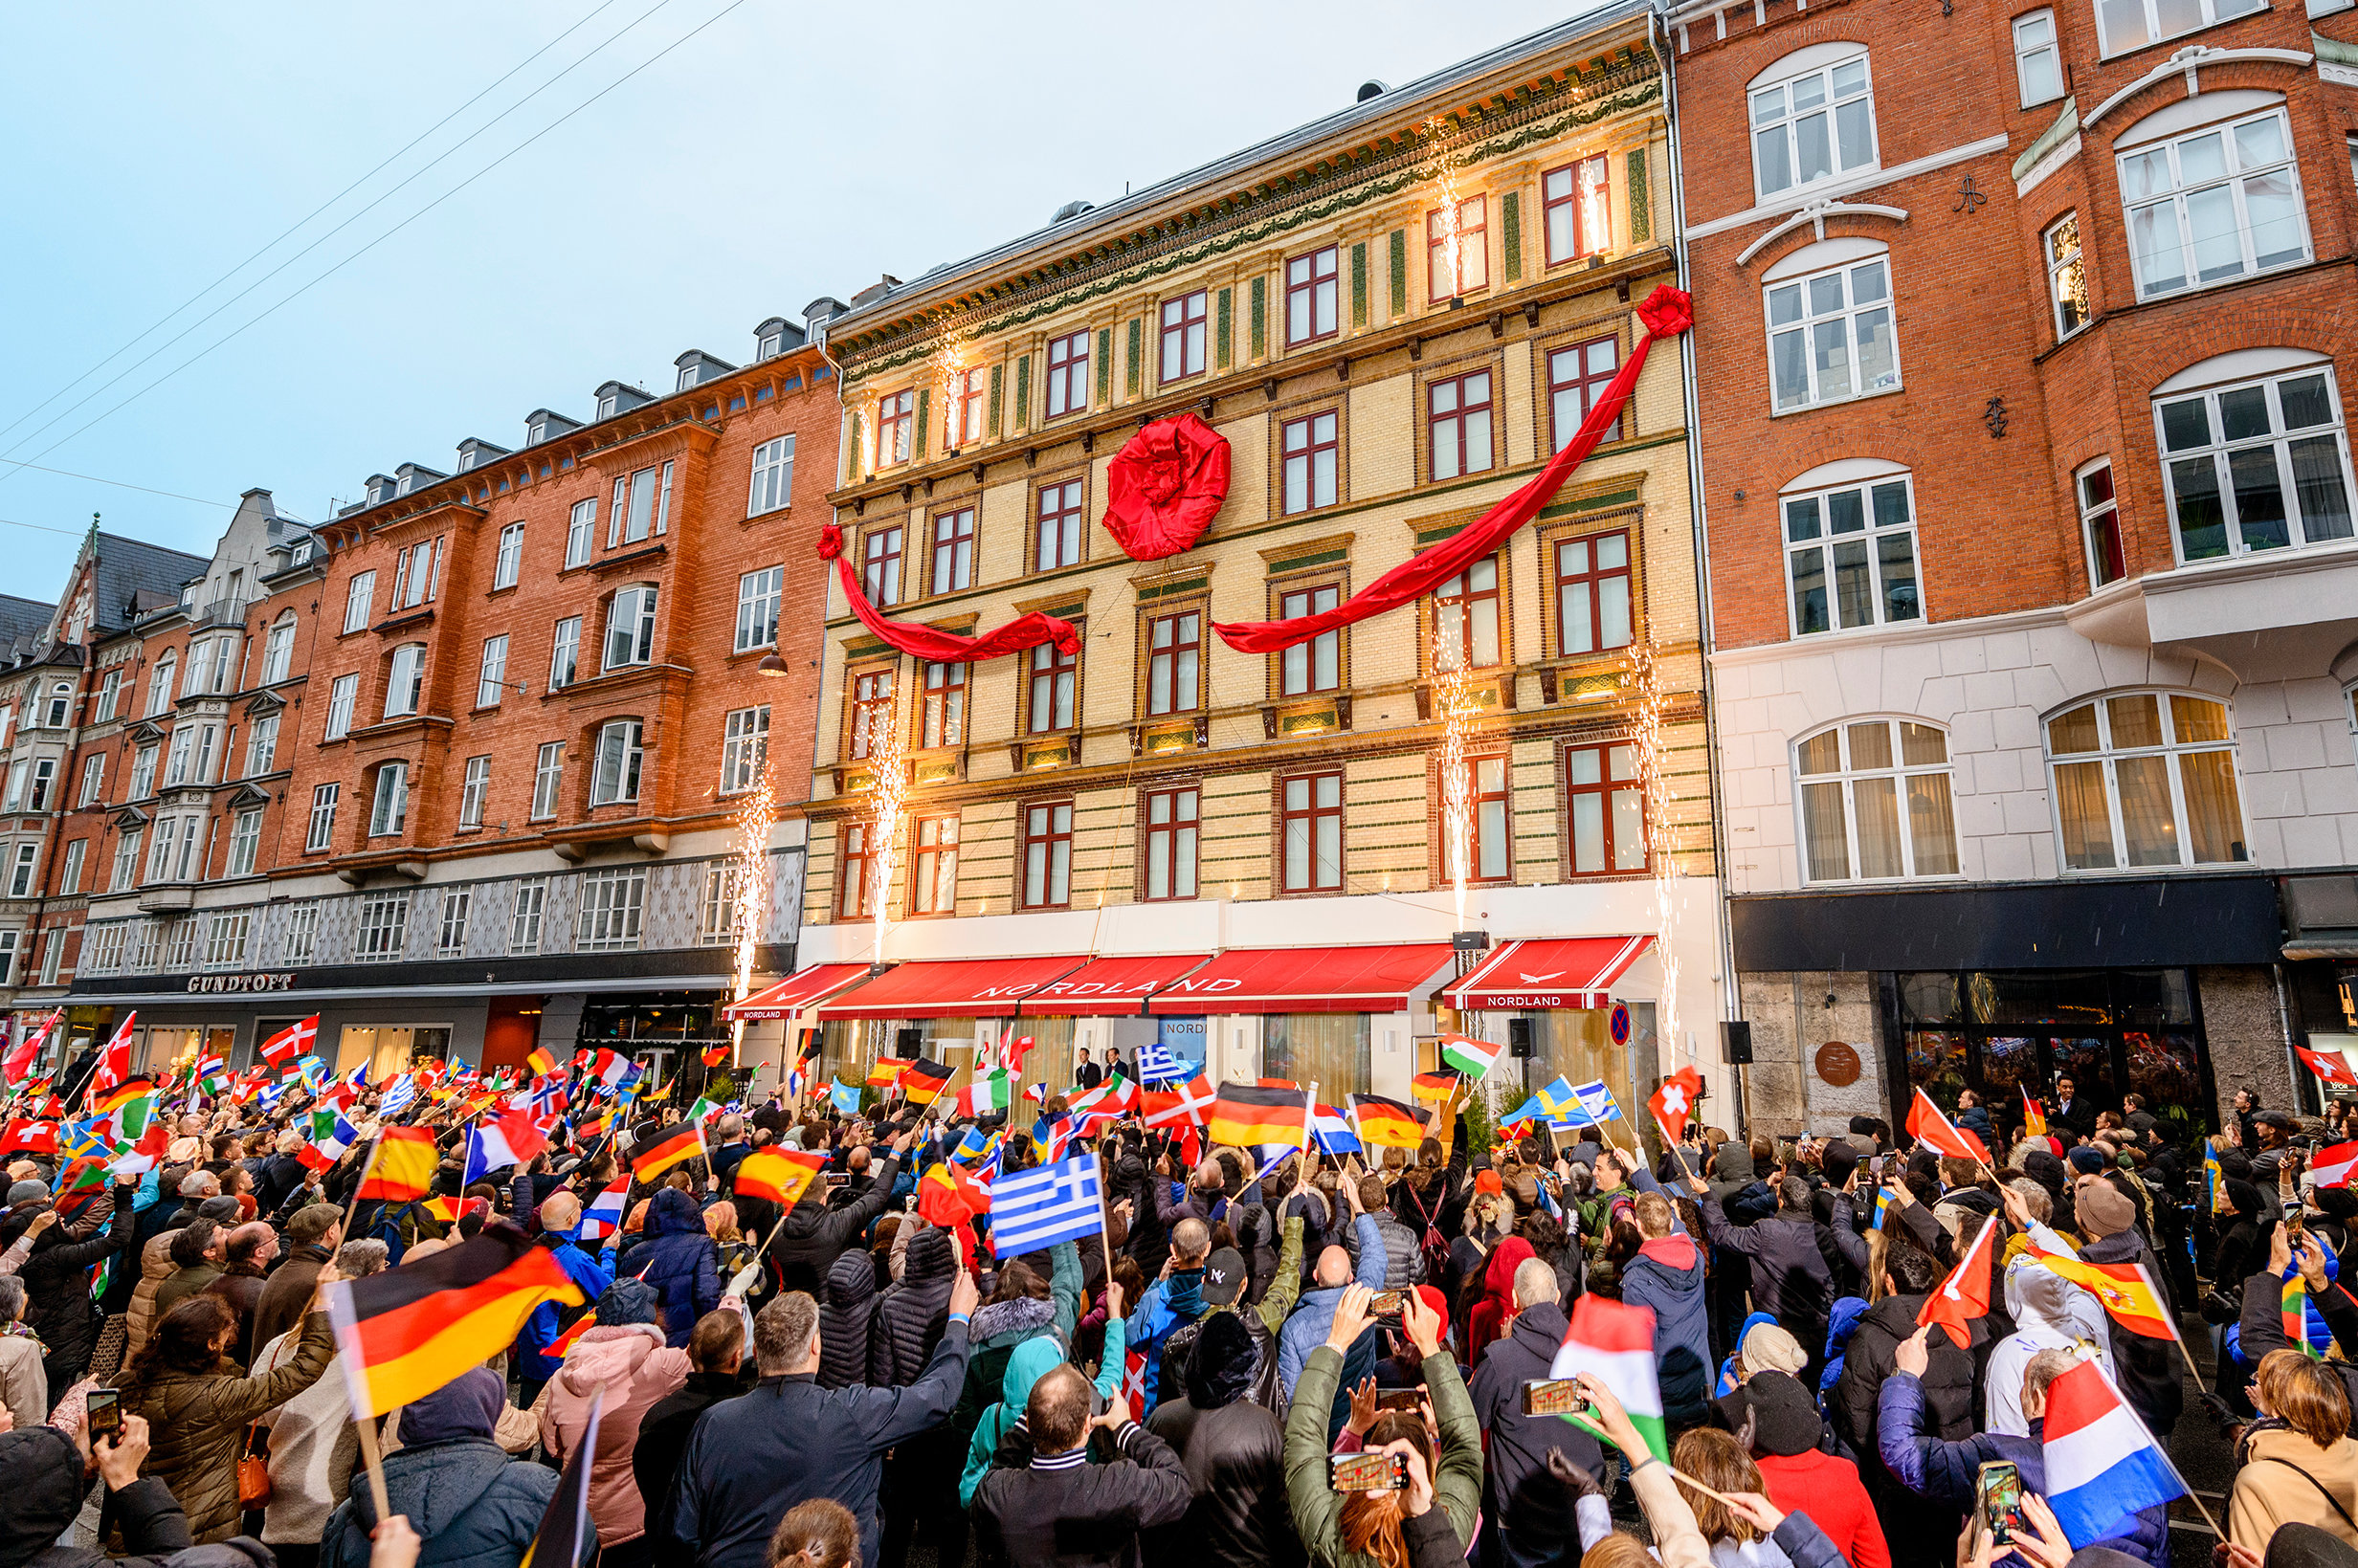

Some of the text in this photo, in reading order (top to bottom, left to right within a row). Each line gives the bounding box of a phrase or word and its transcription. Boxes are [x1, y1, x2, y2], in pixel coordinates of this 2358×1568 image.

[187, 974, 294, 992] GUNDTOFT
[972, 979, 1242, 998] NORDLAND
[1487, 997, 1561, 1006] NORDLAND
[1211, 1268, 1226, 1284] NY
